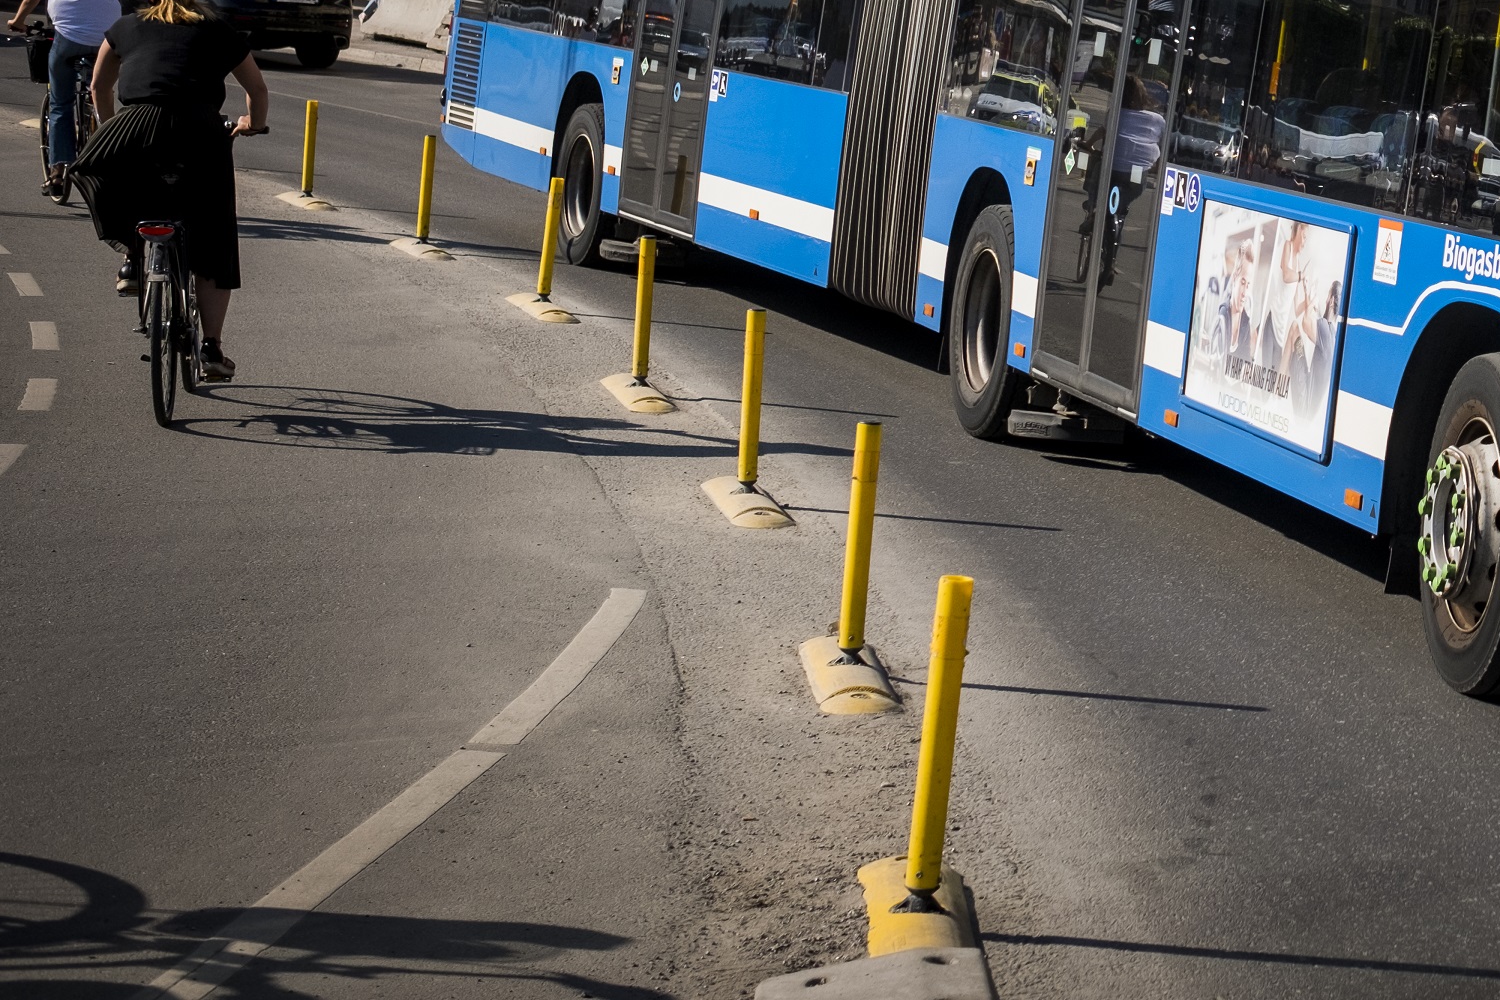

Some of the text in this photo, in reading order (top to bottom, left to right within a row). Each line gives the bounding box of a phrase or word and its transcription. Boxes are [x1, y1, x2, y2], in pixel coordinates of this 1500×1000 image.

[1224, 355, 1291, 399] VI HAR TRÄNING FÖR ALLA
